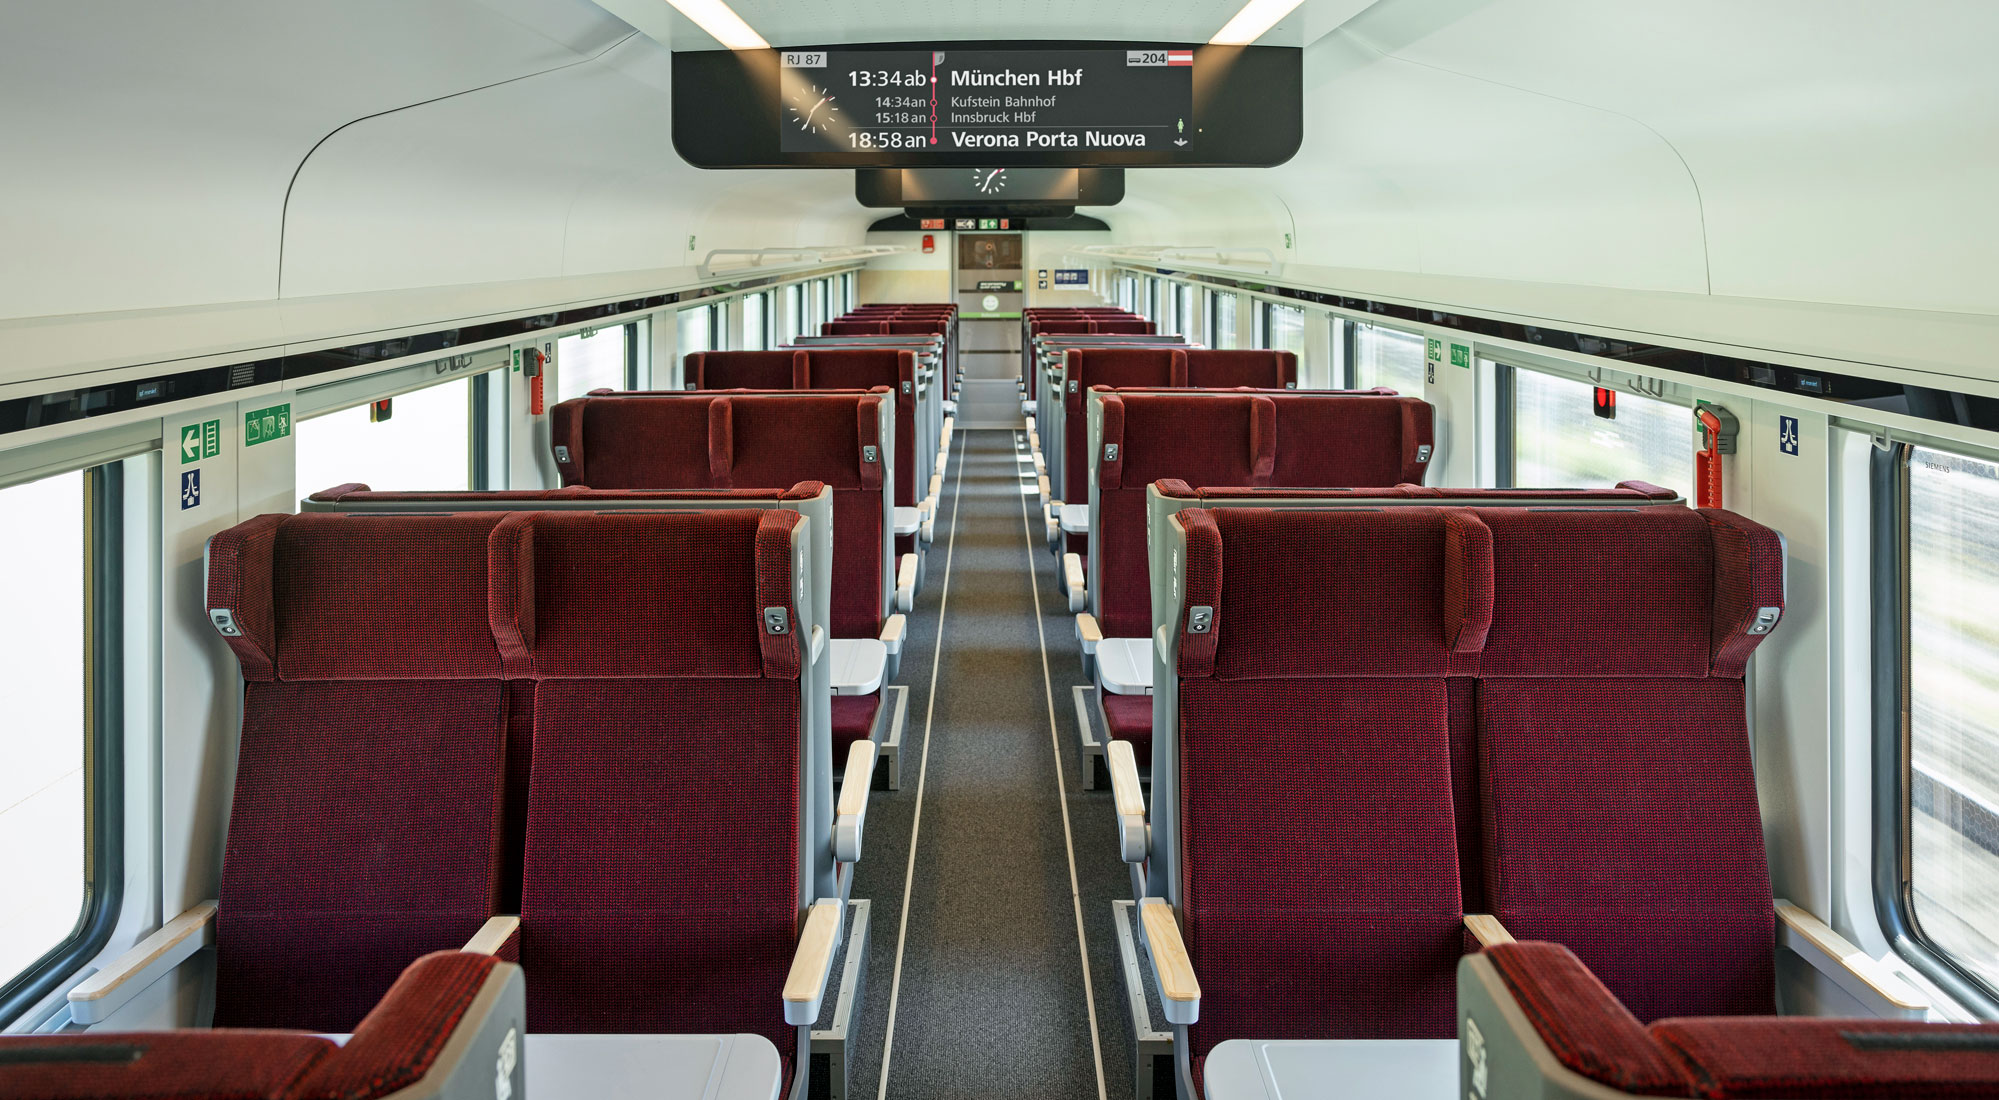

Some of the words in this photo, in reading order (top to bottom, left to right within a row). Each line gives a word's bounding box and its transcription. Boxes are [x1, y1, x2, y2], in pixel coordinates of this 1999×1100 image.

[787, 54, 801, 65] RJ
[805, 54, 822, 65] 87
[1142, 53, 1167, 64] 204
[951, 68, 1041, 87] München
[1047, 68, 1084, 87] Hbf
[951, 95, 1001, 108] Kufstein
[1005, 95, 1057, 108] Bahnhof
[951, 111, 1010, 124] Innsbruck
[1014, 111, 1037, 124] Hbf
[951, 131, 1020, 148] Verona
[1026, 130, 1079, 148] Porta
[1085, 130, 1146, 147] Nuova
[1925, 461, 1950, 474] SIEMENS
